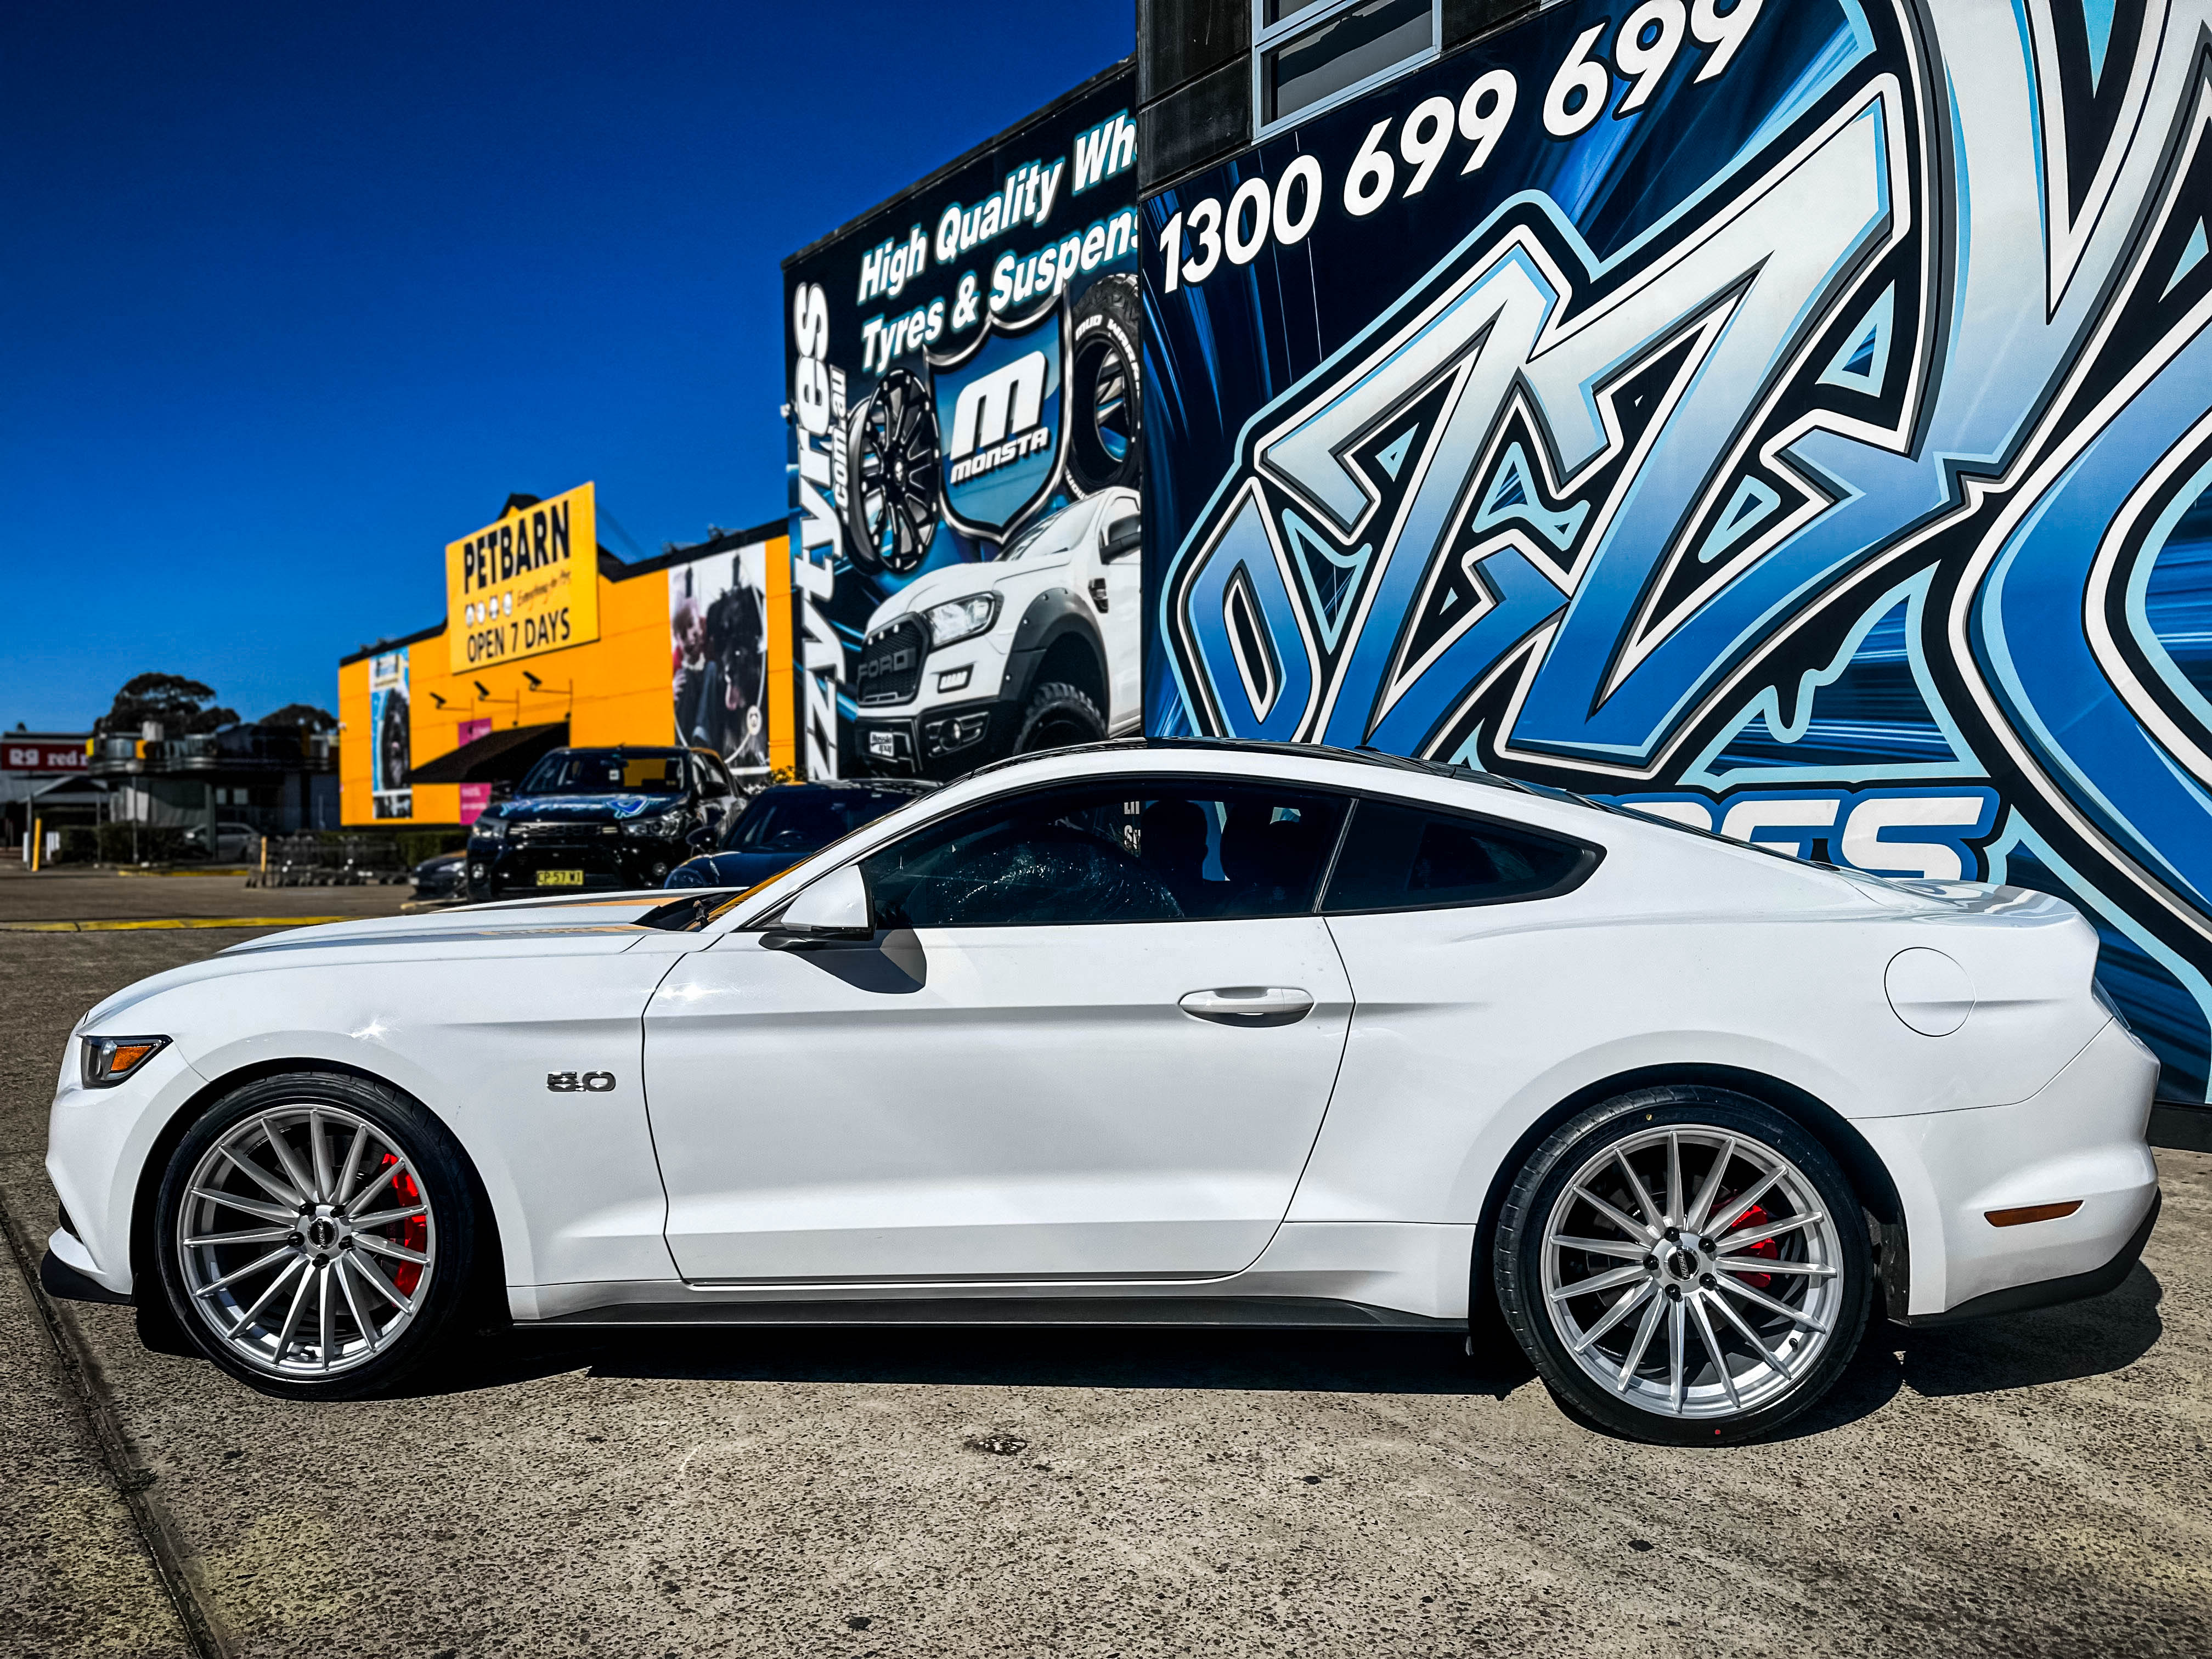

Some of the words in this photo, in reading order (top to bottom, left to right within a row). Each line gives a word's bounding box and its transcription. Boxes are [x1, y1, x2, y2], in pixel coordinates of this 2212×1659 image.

[1159, 155, 1322, 294] 1300
[1343, 69, 1517, 216] 699
[1543, 0, 1763, 137] 699
[859, 227, 927, 303] High
[936, 162, 1063, 261] Quality
[1075, 114, 1137, 192] Wh
[863, 302, 942, 374] Tyres
[953, 274, 978, 328] &
[1075, 314, 1103, 341] MUD
[950, 427, 1048, 483] MONSTA
[464, 500, 570, 594] PETBARN
[467, 626, 504, 662] OPEN
[511, 622, 518, 652] 7
[525, 607, 571, 649] DAYS
[857, 650, 909, 680] FORD
[47, 751, 77, 766] red
